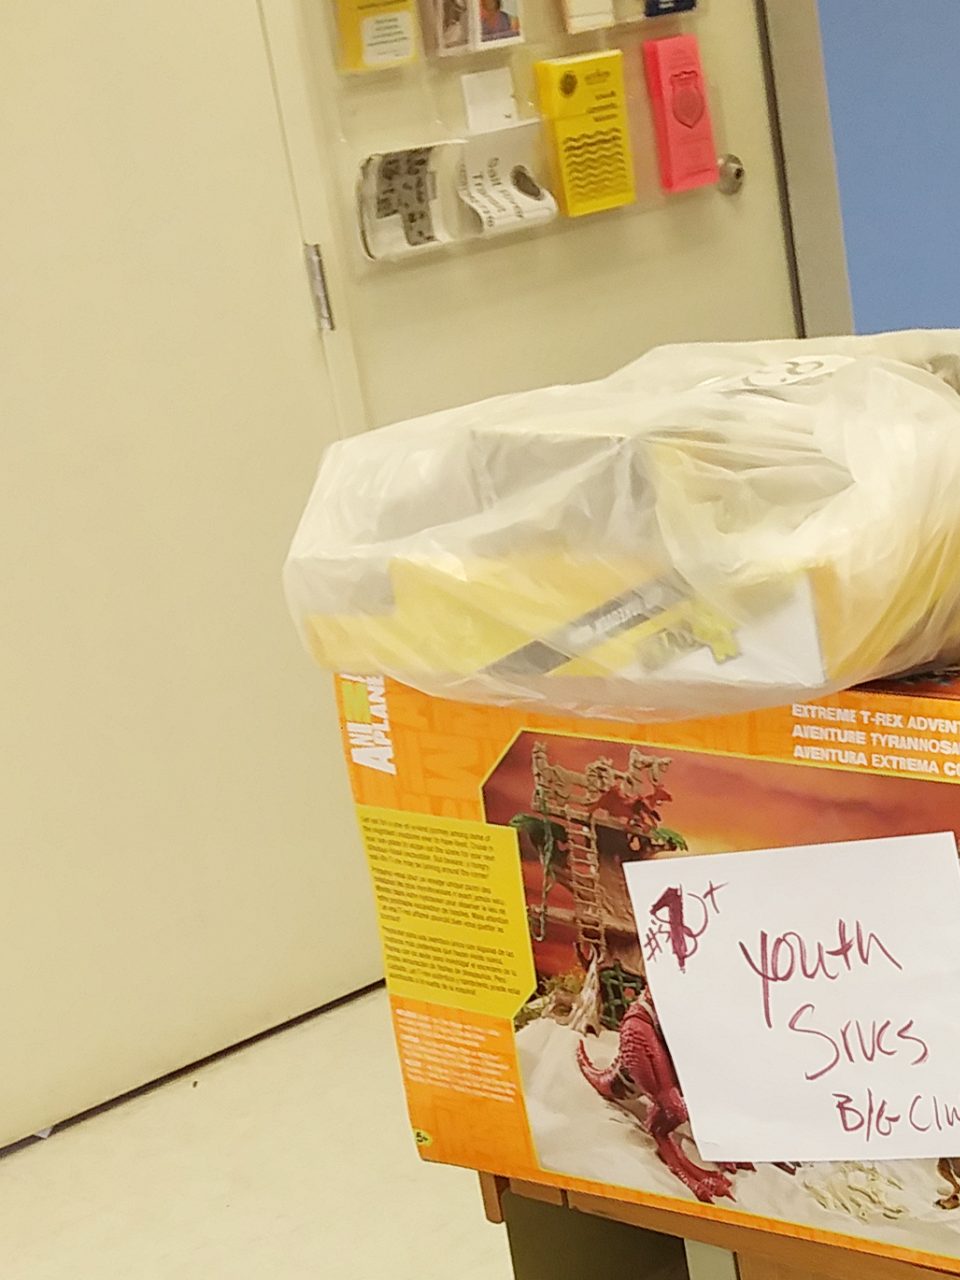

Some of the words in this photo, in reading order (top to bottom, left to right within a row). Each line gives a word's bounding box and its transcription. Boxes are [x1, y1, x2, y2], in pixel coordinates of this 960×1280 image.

[791, 703, 857, 724] EXTREME
[860, 709, 904, 729] T-REX
[791, 724, 866, 745] AVENTURE
[793, 745, 868, 767] AVENTURA
[871, 753, 940, 775] EXTREMA
